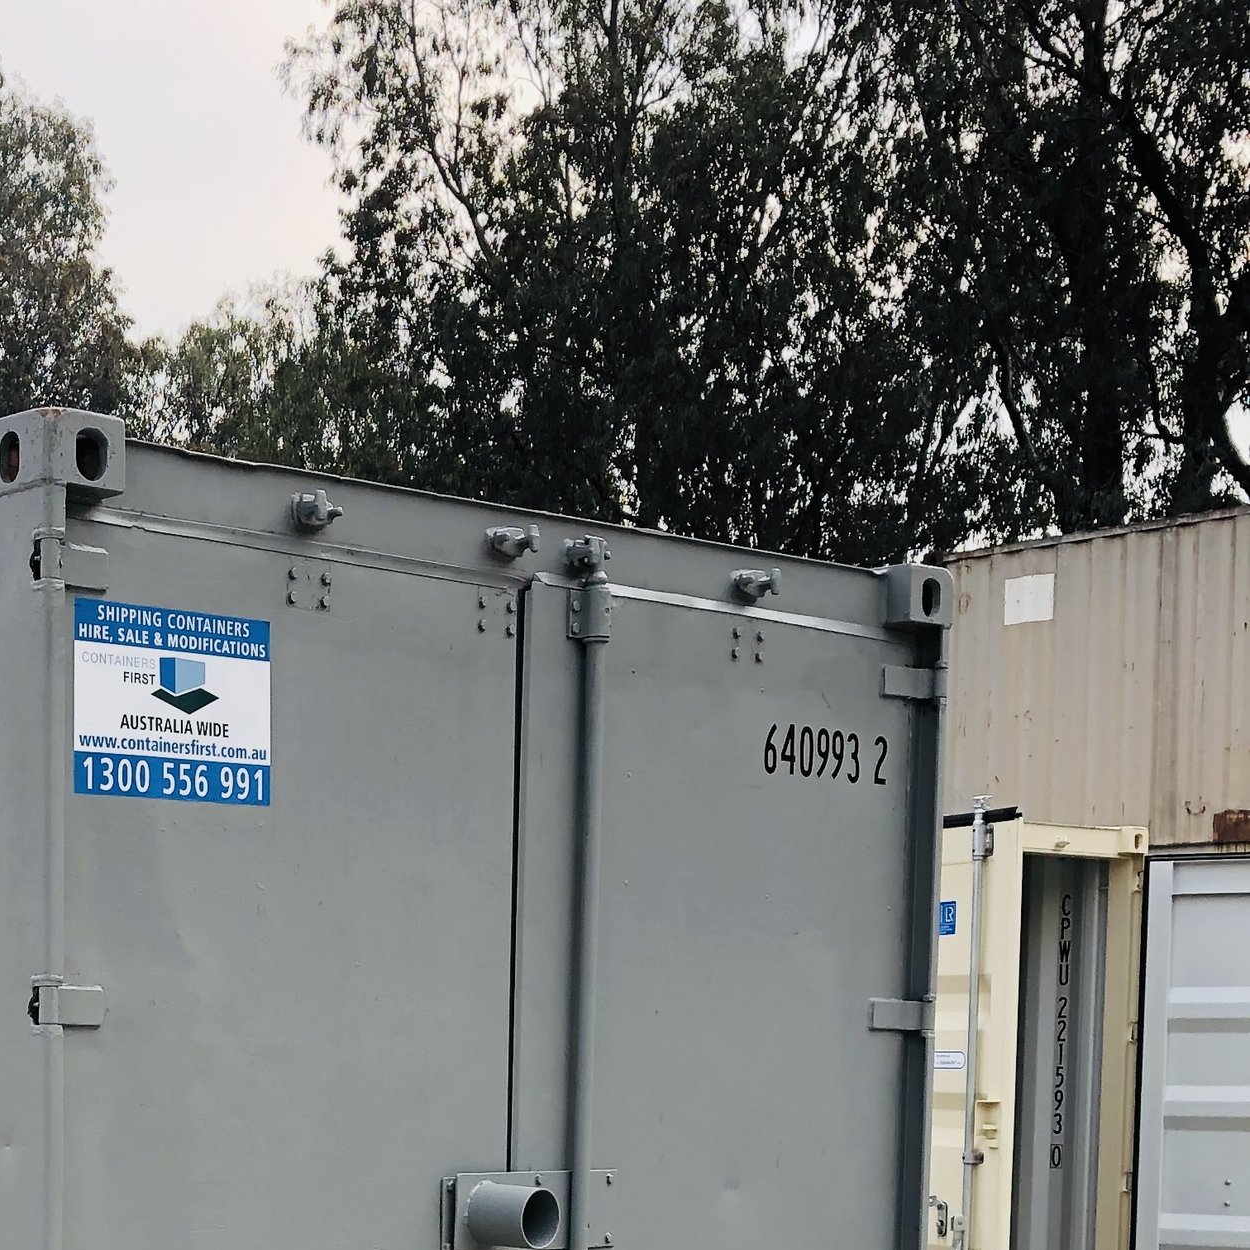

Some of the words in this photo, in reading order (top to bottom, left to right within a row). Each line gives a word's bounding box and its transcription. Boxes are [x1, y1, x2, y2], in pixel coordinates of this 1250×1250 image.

[97, 604, 162, 627] SHIPPING
[167, 614, 250, 638] CONTAINERS
[78, 623, 113, 643] HIRE,
[117, 627, 149, 644] SALE
[154, 631, 163, 646] &
[167, 633, 266, 658] MODIFICATIONS
[81, 651, 156, 670] CONTAINERS
[123, 671, 156, 686] FIRST
[120, 713, 193, 735] AUSTRALIA
[196, 720, 229, 738] WIDE
[79, 734, 267, 761] www.containersfirst.com.au
[764, 723, 860, 784] 640993
[873, 736, 888, 785] 2
[83, 756, 150, 793] 1300
[162, 761, 209, 798] 556
[220, 766, 263, 801] 991
[1058, 894, 1071, 986] CPWU
[1052, 996, 1069, 1136] 221593
[1050, 1144, 1063, 1169] 0
